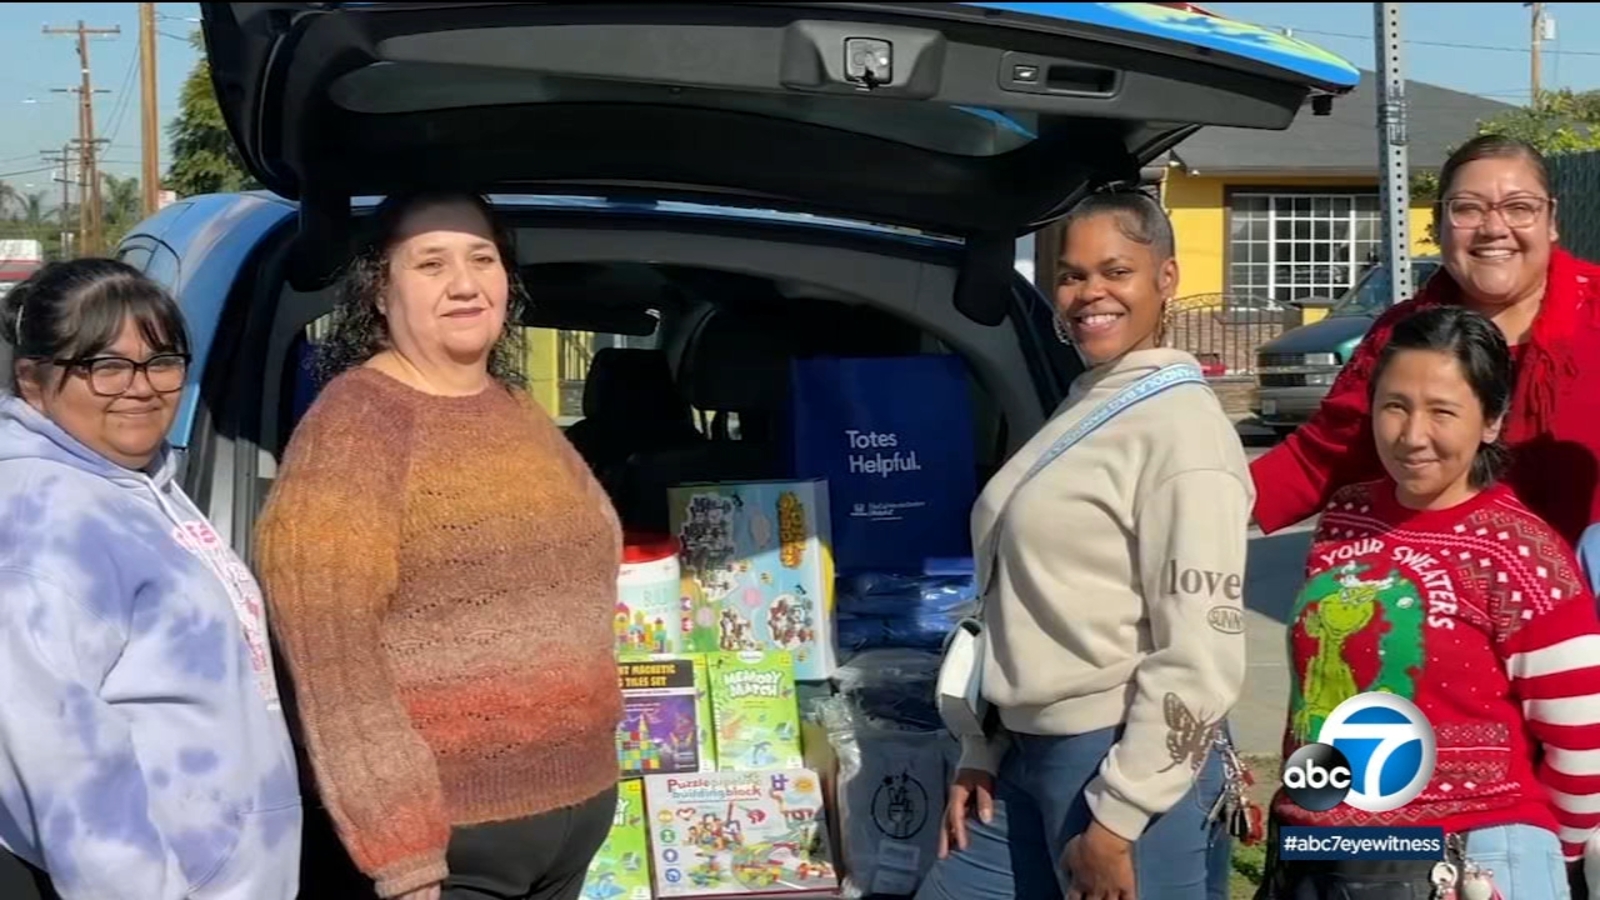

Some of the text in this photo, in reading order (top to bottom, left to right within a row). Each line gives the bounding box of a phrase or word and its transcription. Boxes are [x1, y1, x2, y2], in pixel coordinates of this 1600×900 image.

[845, 430, 898, 449] Totes
[849, 450, 922, 478] Helpful.
[1166, 559, 1241, 600] love
[1320, 538, 1459, 630] YOUR SWEATERS
[631, 664, 677, 675] MAGNETIC
[723, 669, 783, 686] MEMORY
[625, 677, 649, 688] TILES
[650, 676, 668, 687] SET
[729, 682, 779, 698] MATCH
[667, 778, 709, 793] Puzzle
[672, 785, 762, 800] building block
